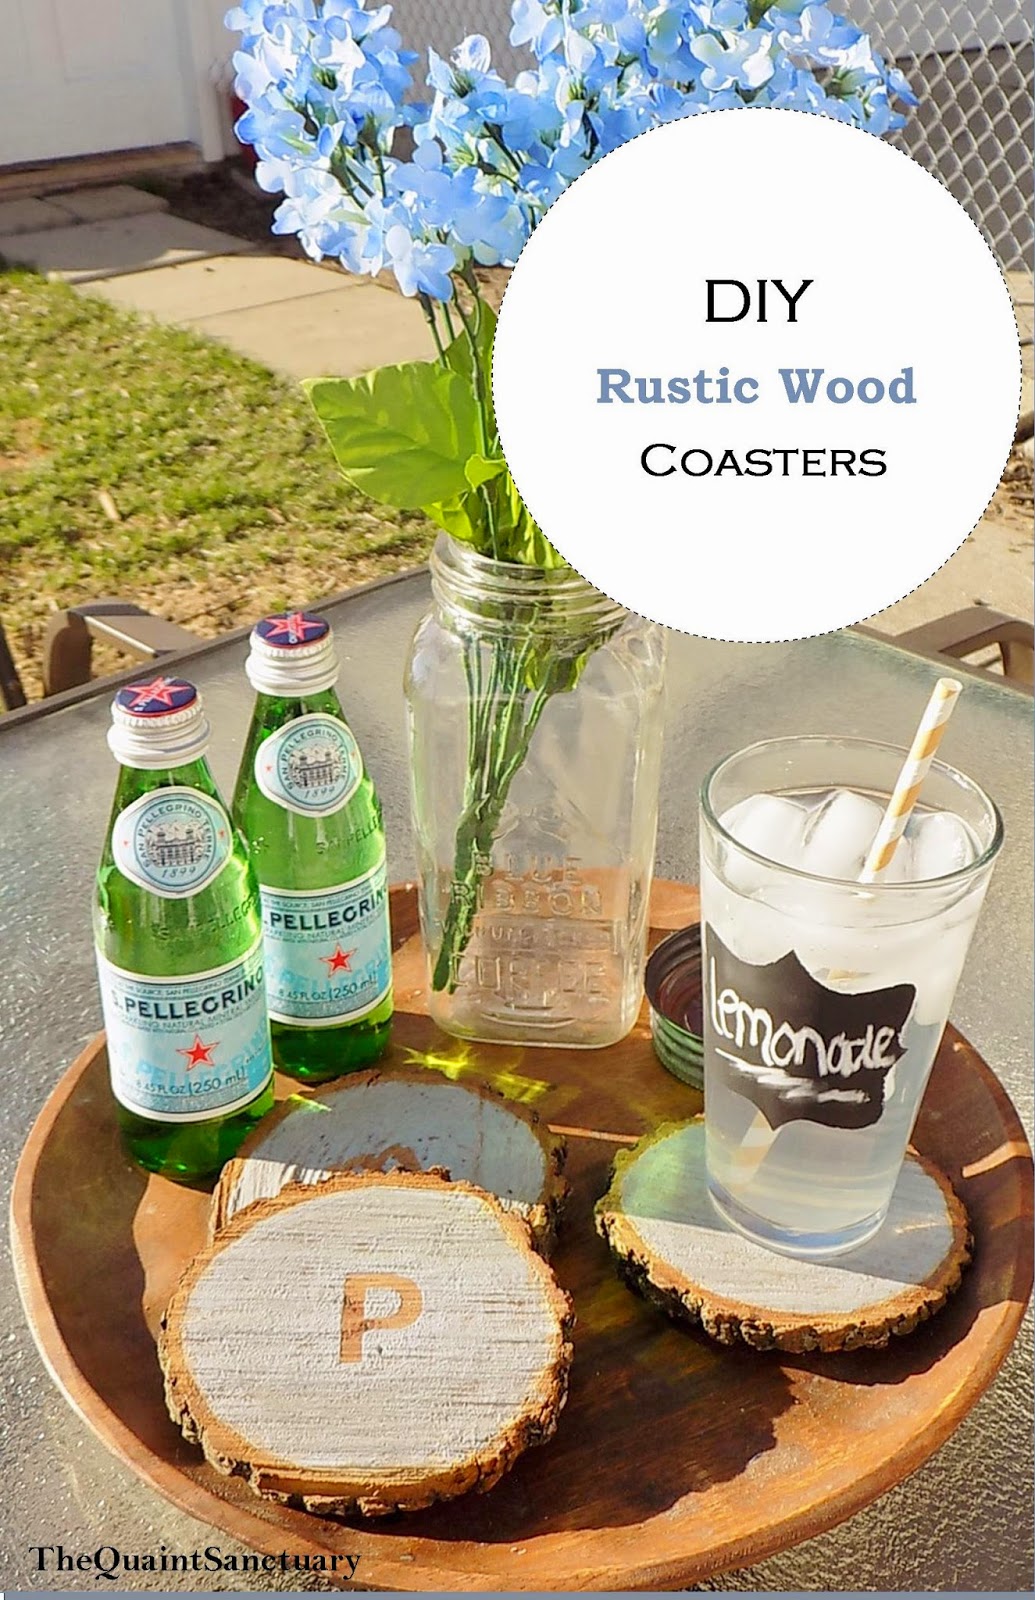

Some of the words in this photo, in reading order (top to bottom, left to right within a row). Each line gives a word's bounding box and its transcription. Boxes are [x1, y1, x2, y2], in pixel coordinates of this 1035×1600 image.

[281, 729, 338, 762] PELLEGRINO
[138, 804, 202, 837] PELLEGRINO
[162, 866, 197, 878] 1899
[475, 851, 583, 884] BLUE
[339, 1272, 423, 1364] P
